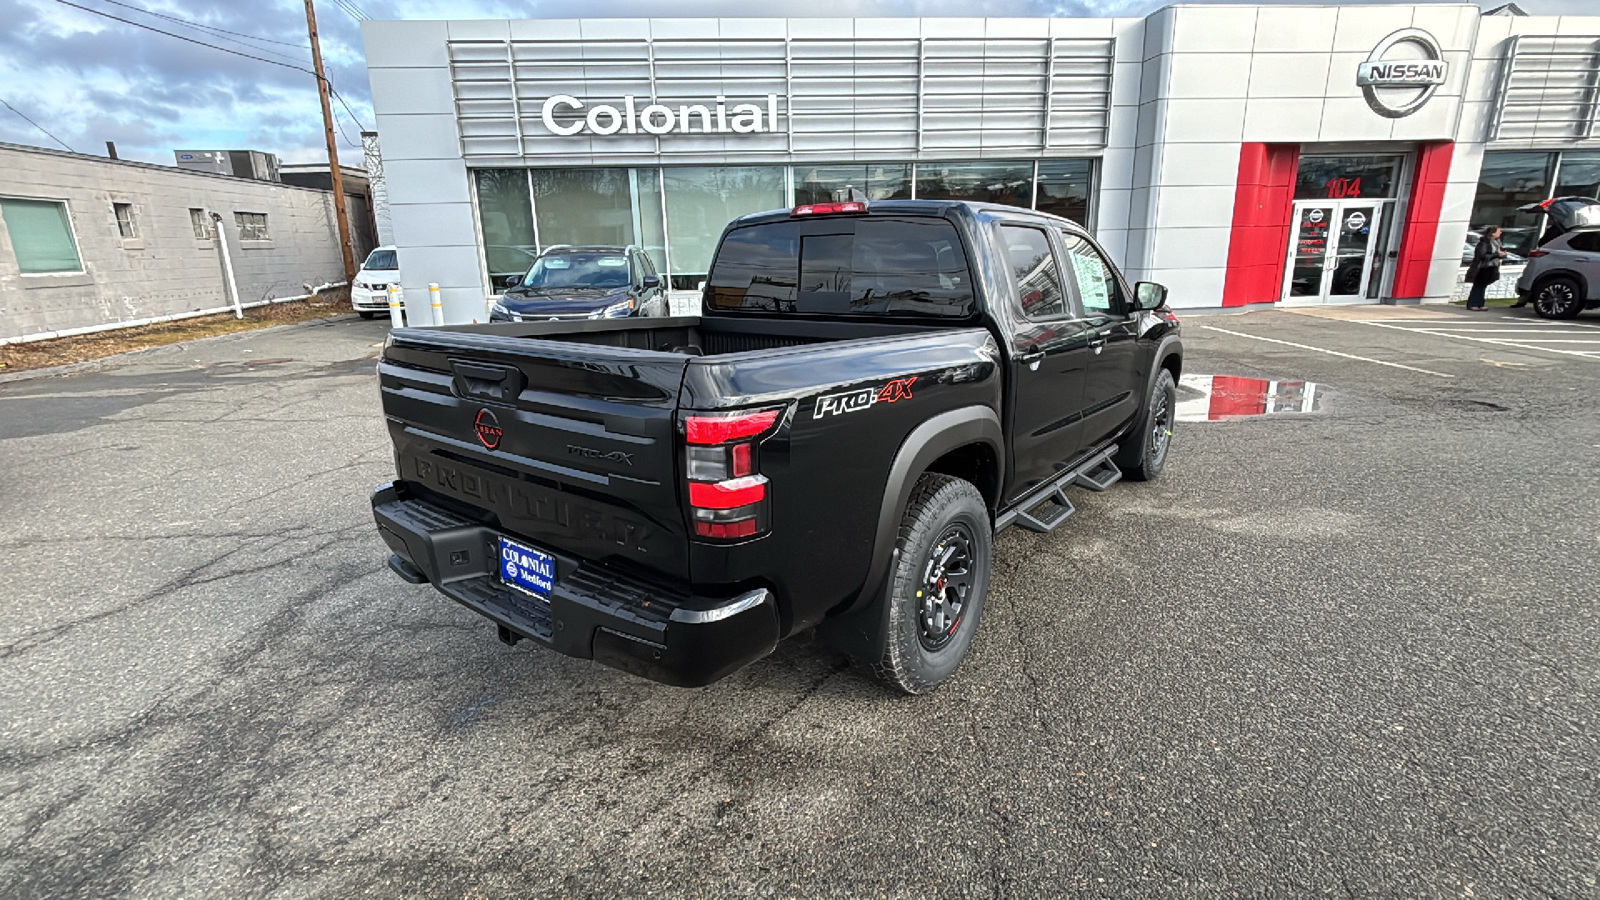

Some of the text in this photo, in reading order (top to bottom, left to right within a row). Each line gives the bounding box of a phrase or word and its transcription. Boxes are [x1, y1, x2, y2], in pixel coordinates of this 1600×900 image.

[1369, 64, 1443, 80] NISSAN
[542, 94, 778, 136] Colonial
[1325, 177, 1361, 198] 104
[502, 547, 554, 579] COLONIAL
[520, 568, 551, 590] Medford
